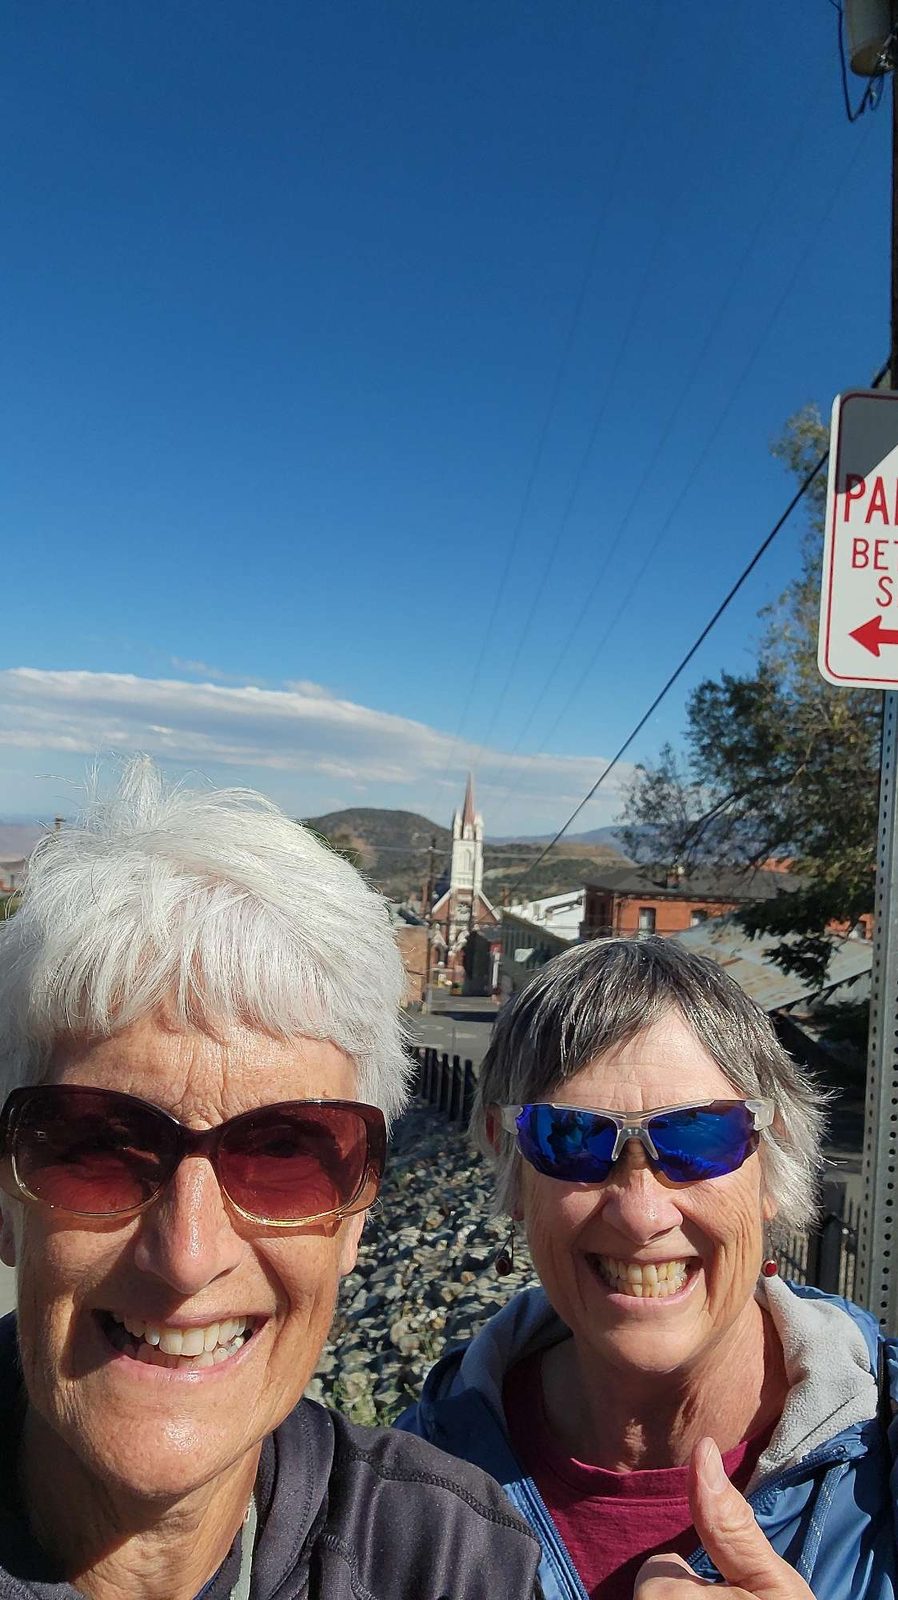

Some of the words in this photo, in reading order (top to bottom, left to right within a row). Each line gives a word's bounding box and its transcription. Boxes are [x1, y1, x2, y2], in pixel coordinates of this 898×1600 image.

[844, 474, 898, 525] PA
[852, 538, 898, 570] BE
[876, 576, 897, 607] S
